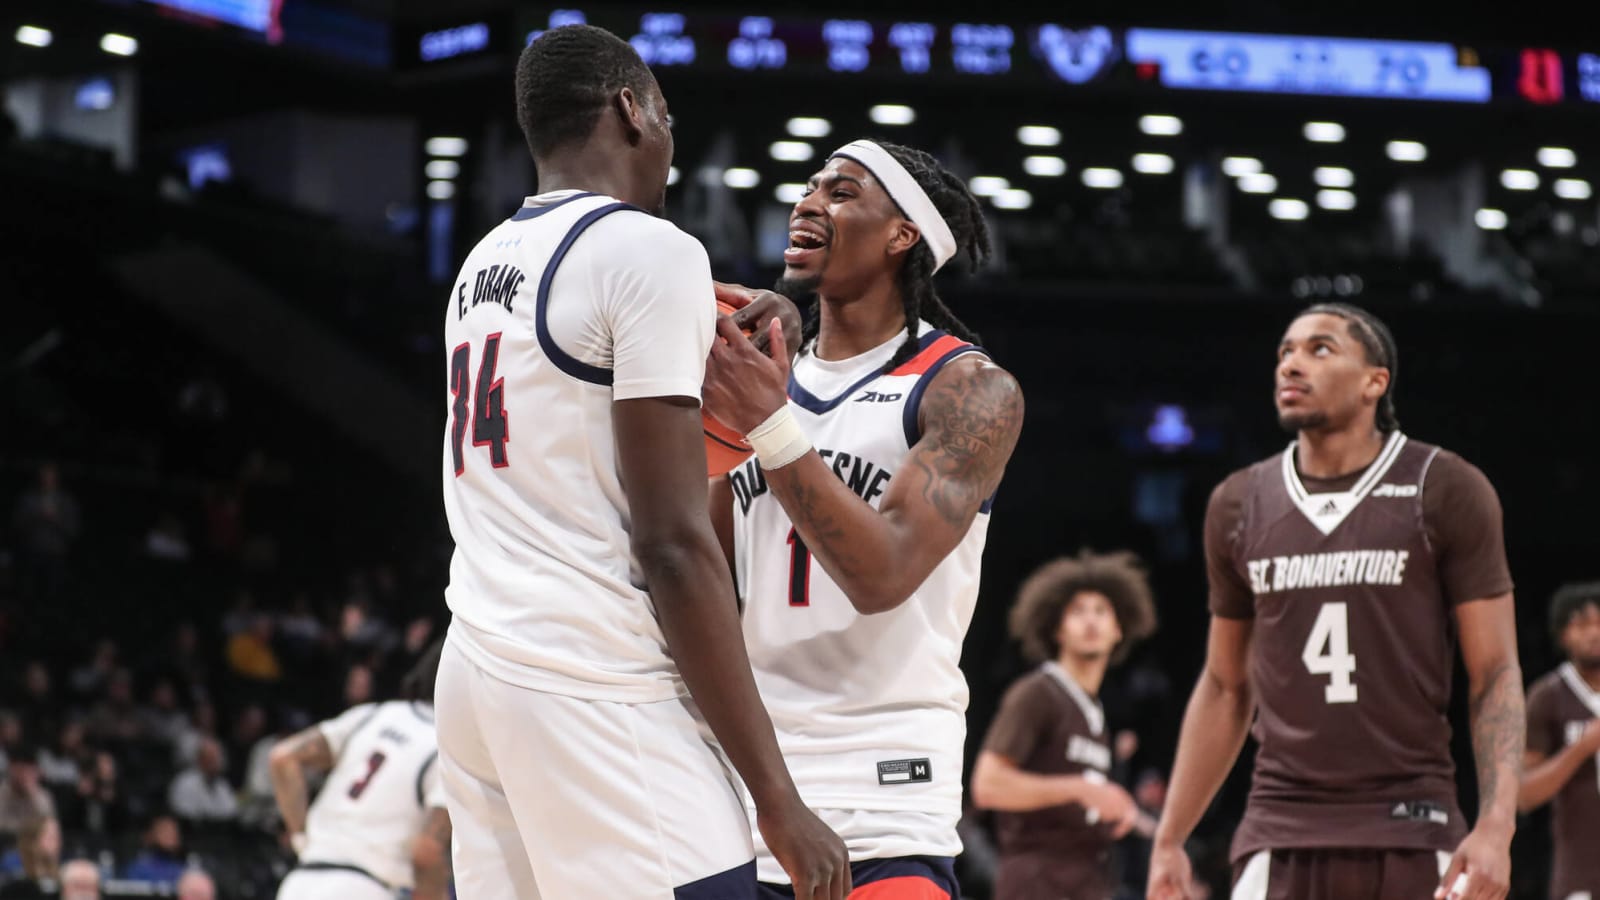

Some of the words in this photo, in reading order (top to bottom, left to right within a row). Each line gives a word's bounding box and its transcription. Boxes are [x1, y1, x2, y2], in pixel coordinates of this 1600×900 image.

[458, 281, 468, 322] F.
[471, 264, 526, 314] DRAME
[786, 523, 812, 608] 1
[1247, 557, 1271, 595] ST.
[1272, 550, 1410, 592] BONAVENTURE
[1301, 601, 1358, 704] 4
[915, 764, 926, 776] M
